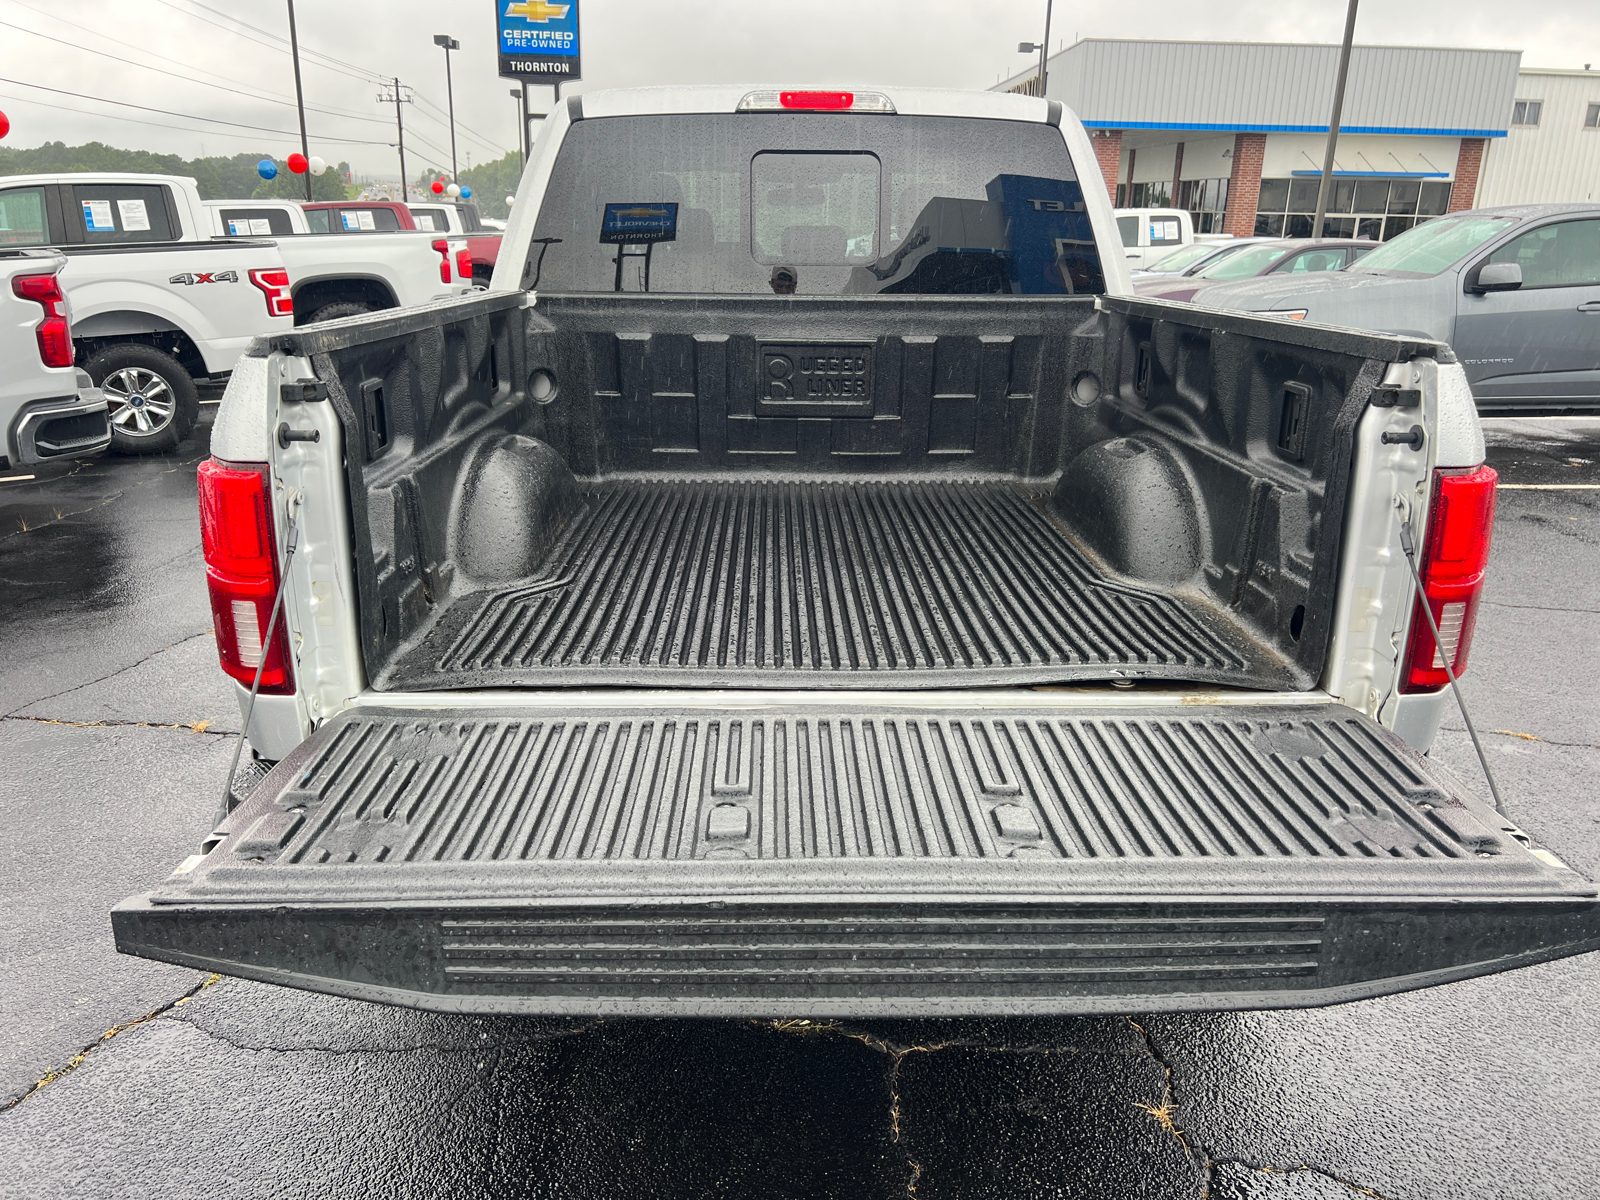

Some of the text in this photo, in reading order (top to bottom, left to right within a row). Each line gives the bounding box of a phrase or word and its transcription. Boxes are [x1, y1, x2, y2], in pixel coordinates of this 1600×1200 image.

[503, 29, 574, 40] CERTIFIED
[507, 39, 571, 49] PRE-OWNED
[510, 61, 569, 73] THORNTON
[808, 379, 866, 396] LINER
